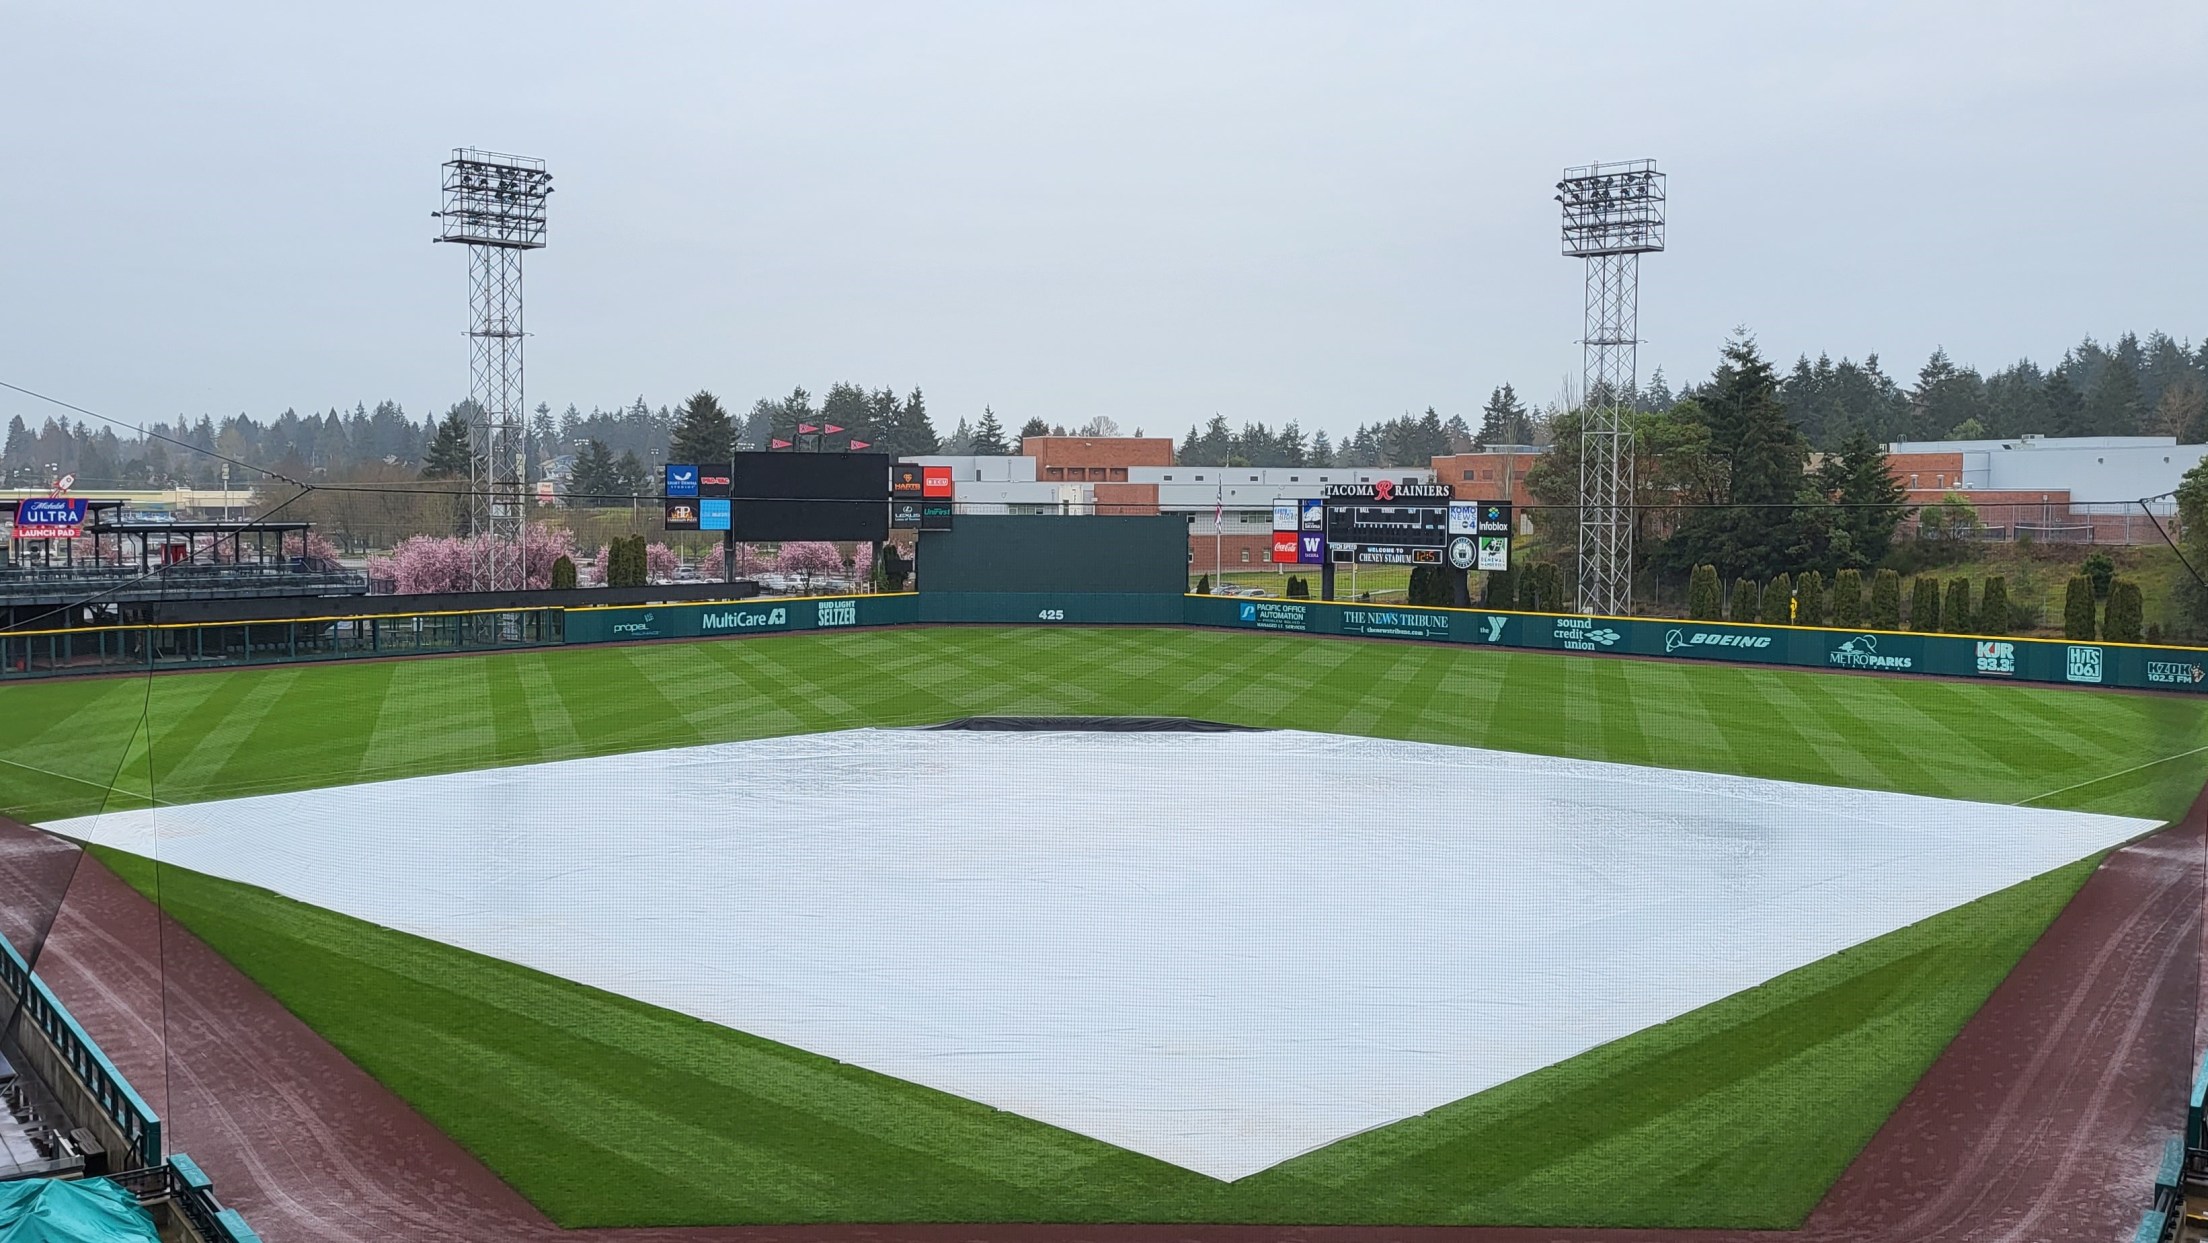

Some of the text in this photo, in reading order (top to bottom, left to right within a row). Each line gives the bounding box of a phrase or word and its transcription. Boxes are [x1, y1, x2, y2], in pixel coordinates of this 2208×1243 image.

[1326, 485, 1374, 496] TACOMA
[1395, 485, 1450, 496] RAINIERS
[28, 511, 78, 522] ULTRA
[1303, 538, 1320, 552] W
[1359, 553, 1411, 563] CHENEY STADIUM
[1282, 605, 1306, 613] OFFICE
[703, 612, 766, 628] MultiCare
[818, 608, 856, 626] SELTZER
[1039, 610, 1063, 620] 425
[1260, 611, 1304, 620] AUTOMATION
[1344, 611, 1448, 628] THE NEWS TRIBUNE
[1557, 618, 1592, 628] sound
[1367, 627, 1423, 636] thenewstribune.com
[1488, 616, 1509, 642] Y
[1554, 629, 1584, 639] credit
[1564, 640, 1595, 650] union
[1690, 633, 1772, 648] BOEING
[1977, 642, 2014, 659] KJR
[1977, 658, 2010, 672] 93.3
[2148, 662, 2192, 676] KZOK
[2148, 674, 2174, 682] 102.5
